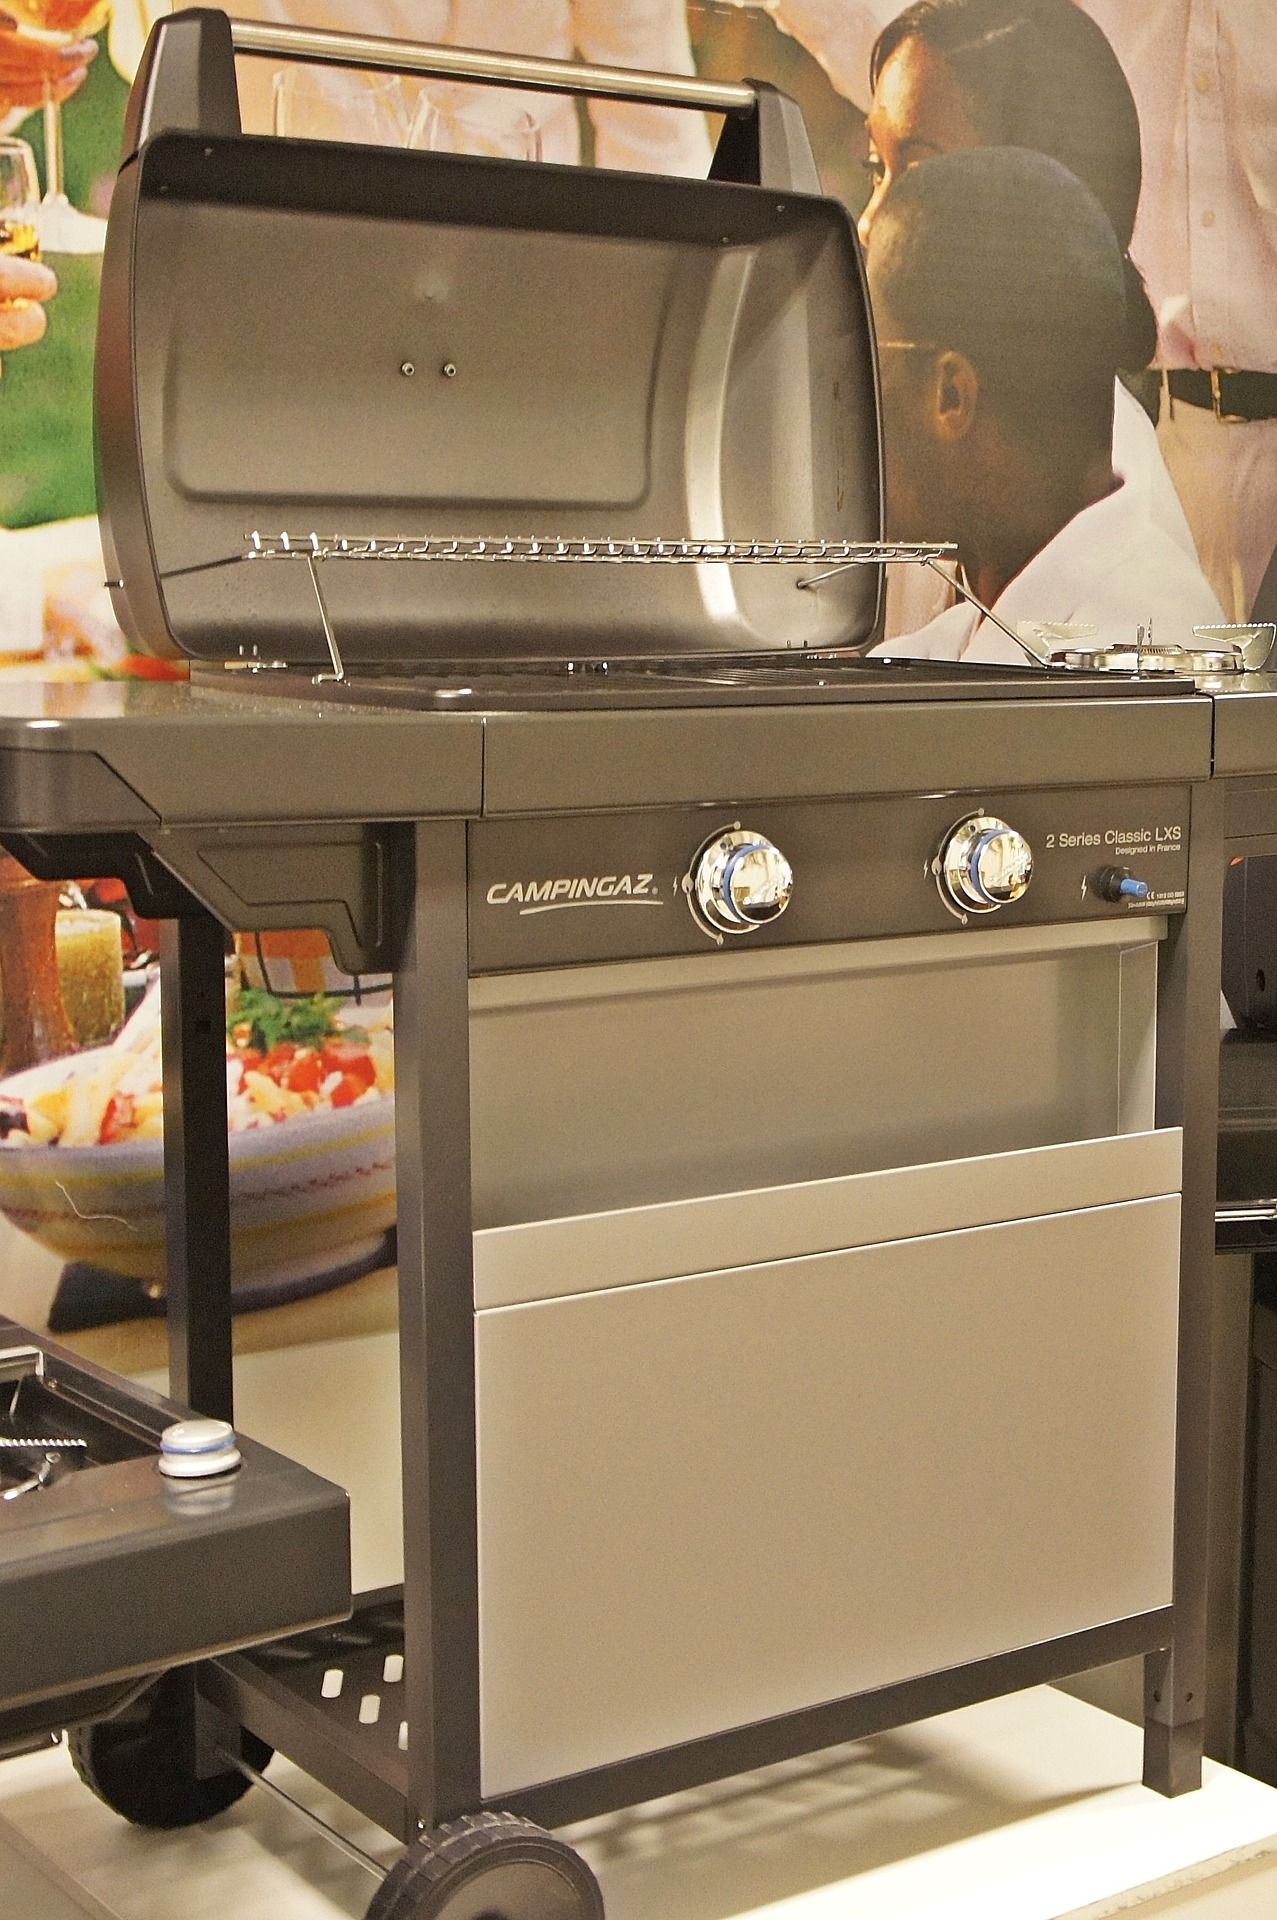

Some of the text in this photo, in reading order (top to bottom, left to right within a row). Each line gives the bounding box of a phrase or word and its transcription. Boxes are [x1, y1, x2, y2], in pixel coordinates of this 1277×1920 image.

[1046, 826, 1182, 848] 2 Series Classic LXS
[1115, 845, 1148, 856] Designed
[1156, 843, 1181, 852] France
